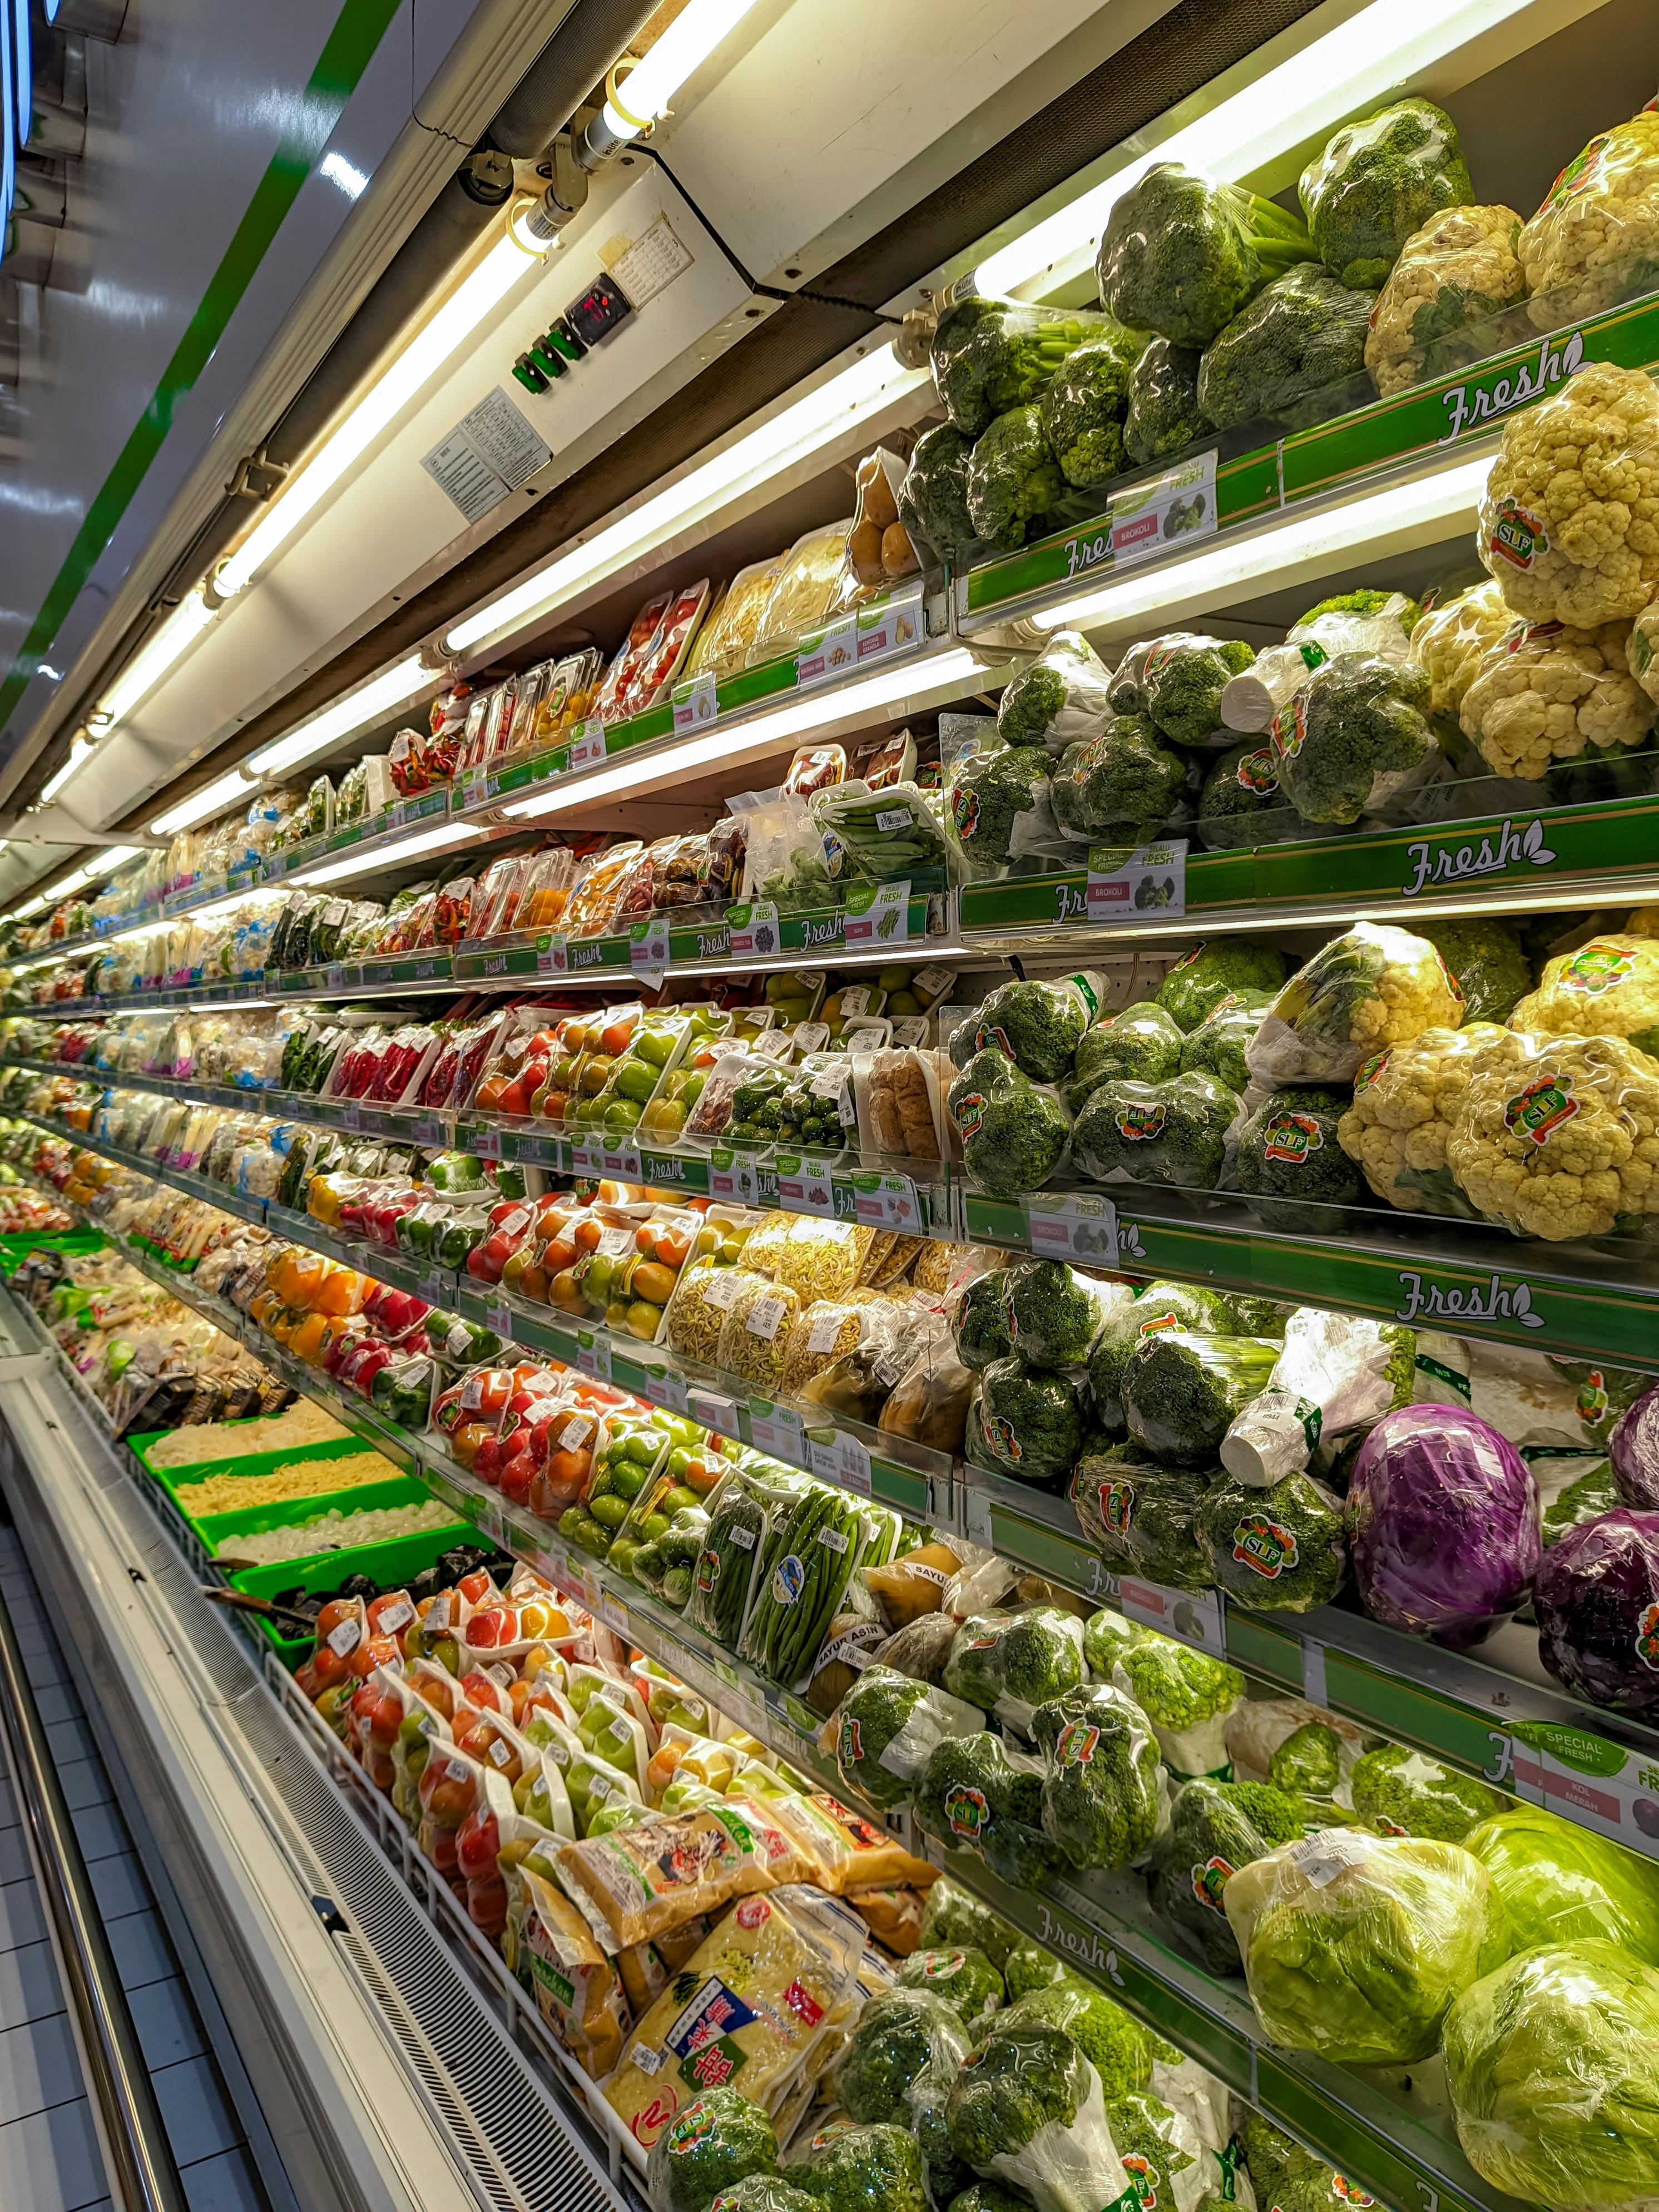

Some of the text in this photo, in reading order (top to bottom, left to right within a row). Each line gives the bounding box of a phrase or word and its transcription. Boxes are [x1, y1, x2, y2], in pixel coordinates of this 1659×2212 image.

[1438, 340, 1561, 446] Fresh
[1121, 523, 1150, 542] BROKOLI
[1499, 525, 1531, 551] SLF
[1061, 526, 1115, 584] Fres
[956, 799, 967, 827] SLF
[1093, 851, 1125, 863] SPECIAL
[1149, 844, 1171, 853] SELALU
[1402, 819, 1523, 896] Fresh
[1142, 852, 1175, 866] FRESH
[849, 893, 870, 904] SPECIAL
[880, 891, 903, 904] FRESH
[1095, 888, 1123, 897] BROKOLI
[728, 909, 746, 919] SPECIAL
[755, 910, 772, 921] FRESH
[800, 908, 843, 953] Fresh
[697, 925, 730, 961] Fresh
[484, 953, 503, 977] Fresh
[572, 942, 597, 971] Fresh
[1524, 1091, 1561, 1125] SLF
[959, 1109, 976, 1130] SLF
[1274, 1132, 1304, 1148] SLF
[647, 1155, 678, 1184] Fresh
[736, 1160, 751, 1170] FRESH
[806, 1167, 825, 1179] FRESH
[885, 1180, 907, 1192] FRESH
[1076, 1204, 1105, 1218] FRESH
[1037, 1225, 1062, 1237] BROKOLI
[1395, 1273, 1512, 1323] Fresh
[779, 1412, 796, 1423] FRESH
[991, 1431, 1005, 1454] SLF
[1108, 1495, 1117, 1525] SLF
[1244, 1536, 1277, 1562] SLF
[916, 1566, 944, 1583] SAYU
[1130, 1589, 1155, 1605] BROKOLI
[852, 1626, 879, 1642] ASIN
[1068, 1730, 1083, 1754] SLF
[1545, 1731, 1603, 1755] SPECIAL
[1558, 1745, 1593, 1763] FRESH
[1571, 1782, 1591, 1797] KOL
[1565, 1791, 1598, 1812] MERAH
[1035, 1904, 1110, 1971] Fresh
[677, 2114, 701, 2138] SLF
